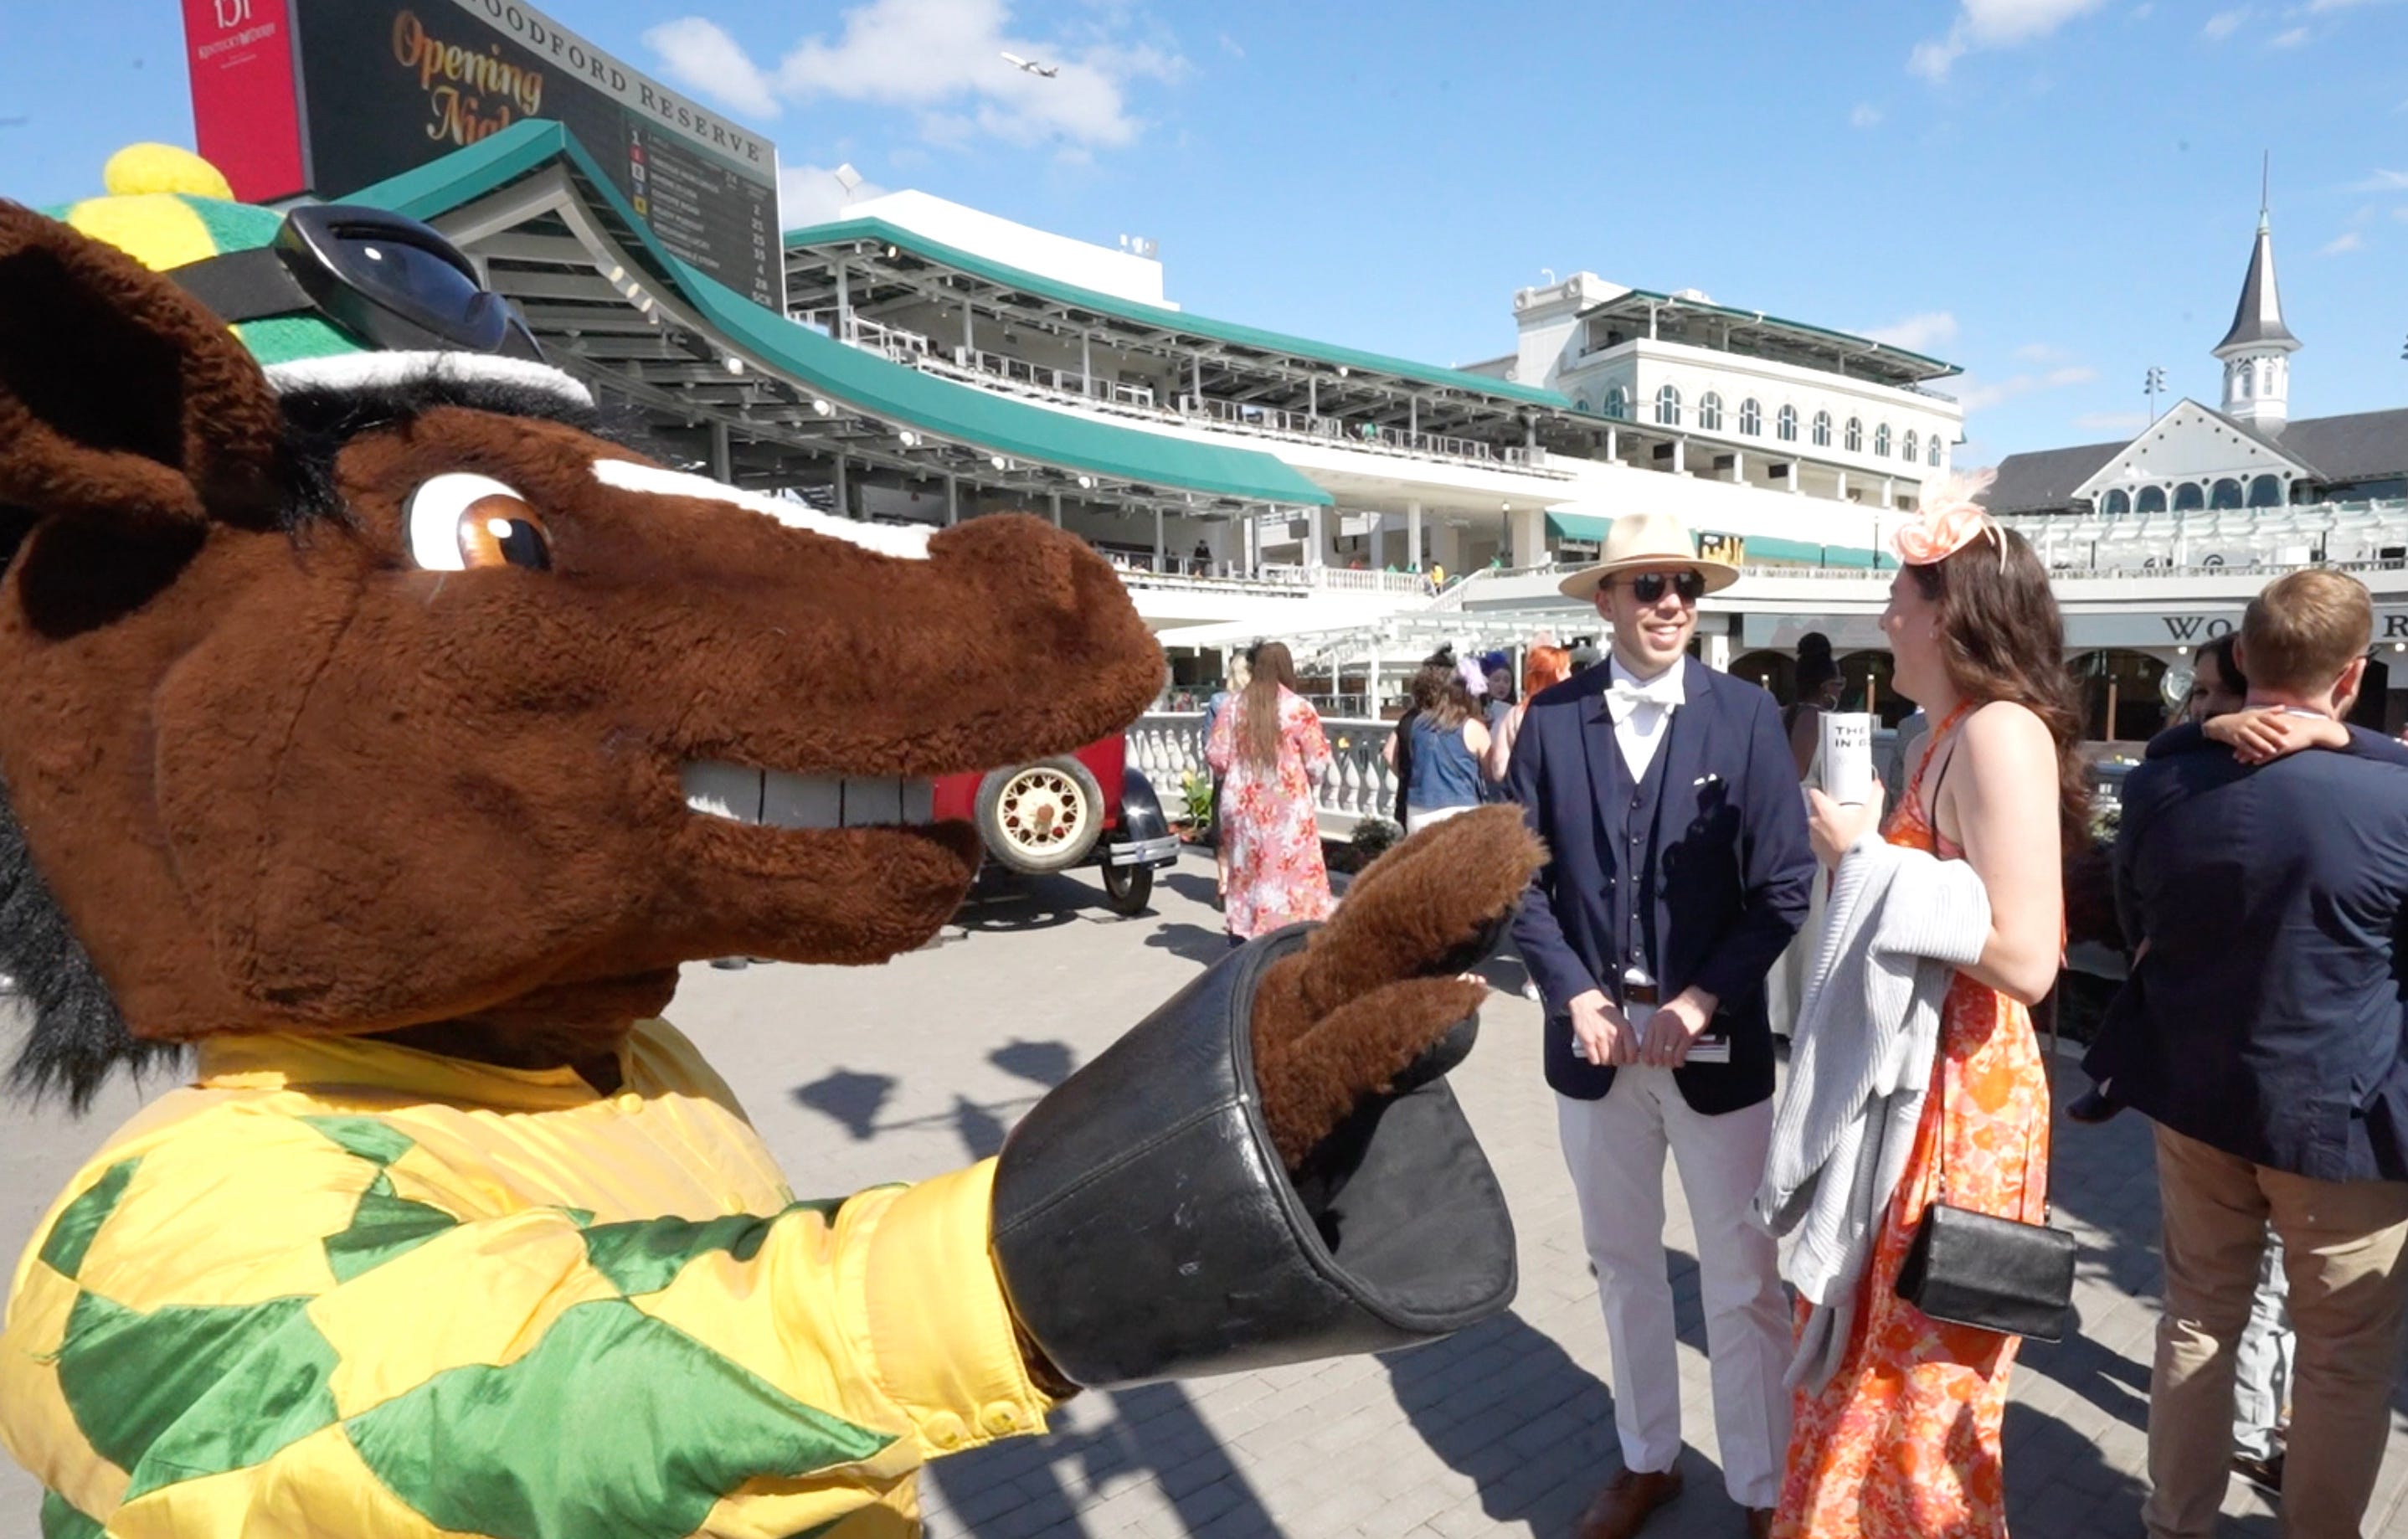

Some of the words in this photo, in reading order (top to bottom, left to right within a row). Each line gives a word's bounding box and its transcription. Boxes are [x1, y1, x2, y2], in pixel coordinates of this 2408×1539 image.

[393, 9, 543, 116] Opening
[472, 0, 626, 91] OODFORD
[639, 82, 759, 162] RESERVE
[1835, 738, 1851, 748] IN
